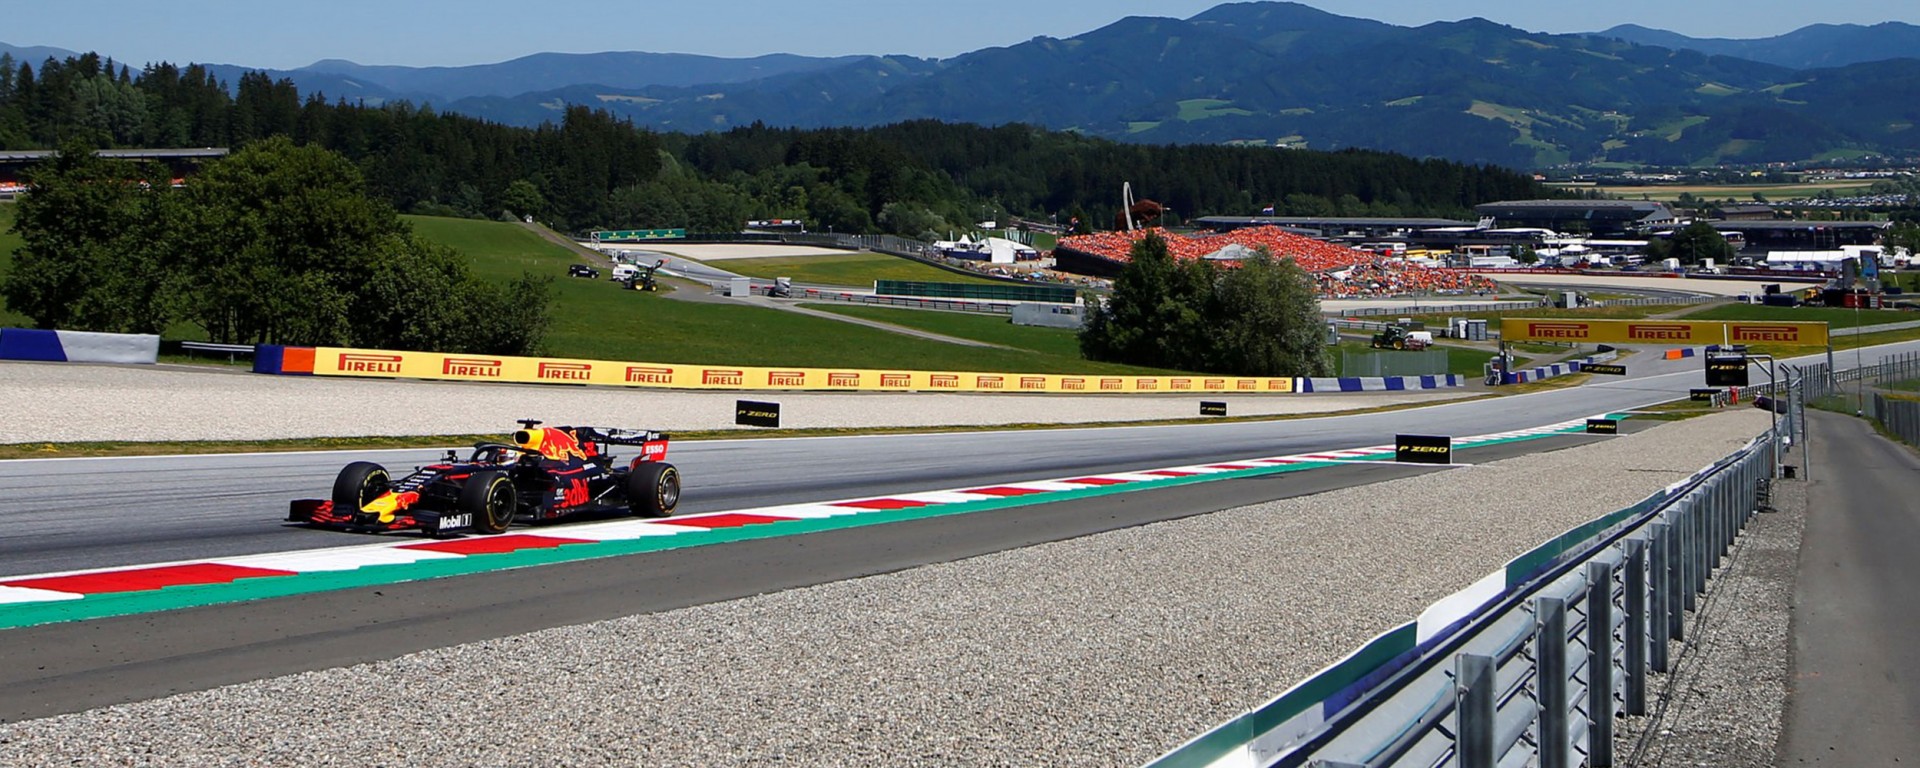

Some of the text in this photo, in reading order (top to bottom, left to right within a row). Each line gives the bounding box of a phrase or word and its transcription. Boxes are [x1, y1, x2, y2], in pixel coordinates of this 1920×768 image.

[1528, 324, 1588, 337] PIRELLI
[1628, 325, 1691, 339] PIRELLI
[1733, 325, 1798, 341] PIRELLI
[338, 352, 403, 373] PIRELLI
[442, 358, 502, 377] PIRELLI
[538, 362, 592, 380] PIRELLI
[626, 366, 673, 383] PIRELLI
[702, 370, 743, 385] PIRELLI
[768, 371, 805, 386] PIRELLI
[828, 373, 859, 387] PIRELLI
[880, 374, 911, 387] PIRELLI
[930, 375, 958, 388] PIRELLI
[977, 376, 1004, 388] PIRELLI
[1020, 377, 1045, 389] PIRELLI
[1061, 378, 1085, 389] PIRELLI
[1100, 379, 1122, 389] PIRELLI
[1136, 379, 1157, 390] PIRELLI
[1170, 379, 1191, 390] PIRELLI
[1204, 379, 1225, 390] PIRELLI
[1237, 380, 1256, 390] PIRELLI
[1268, 380, 1287, 390] PIRELLI
[747, 410, 777, 418] ZERO
[646, 444, 664, 454] ESSO
[439, 514, 461, 530] Mobil
